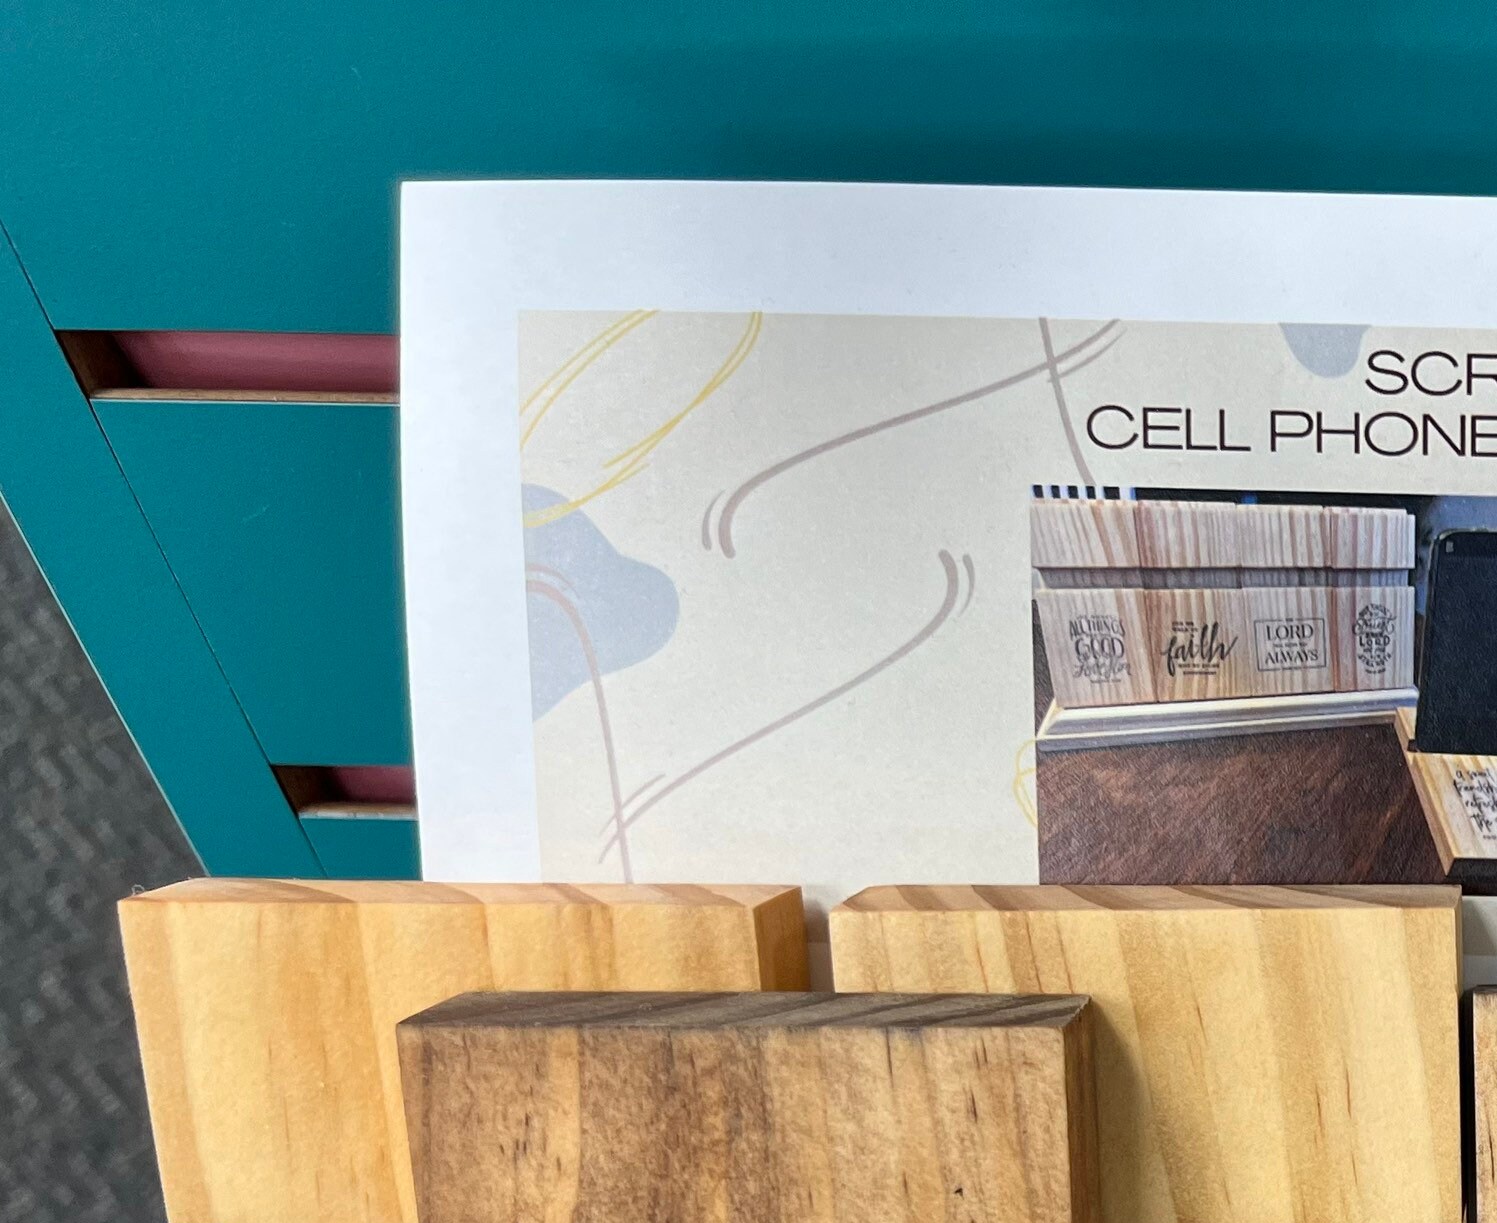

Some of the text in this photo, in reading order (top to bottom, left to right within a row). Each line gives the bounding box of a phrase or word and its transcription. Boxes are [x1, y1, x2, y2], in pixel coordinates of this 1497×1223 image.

[1086, 404, 1251, 452] CELL
[1266, 622, 1314, 641] LORD
[1359, 634, 1391, 648] LORD
[1075, 637, 1125, 660] GOOD
[1160, 620, 1239, 677] faith
[1265, 649, 1319, 666] ALWAYS
